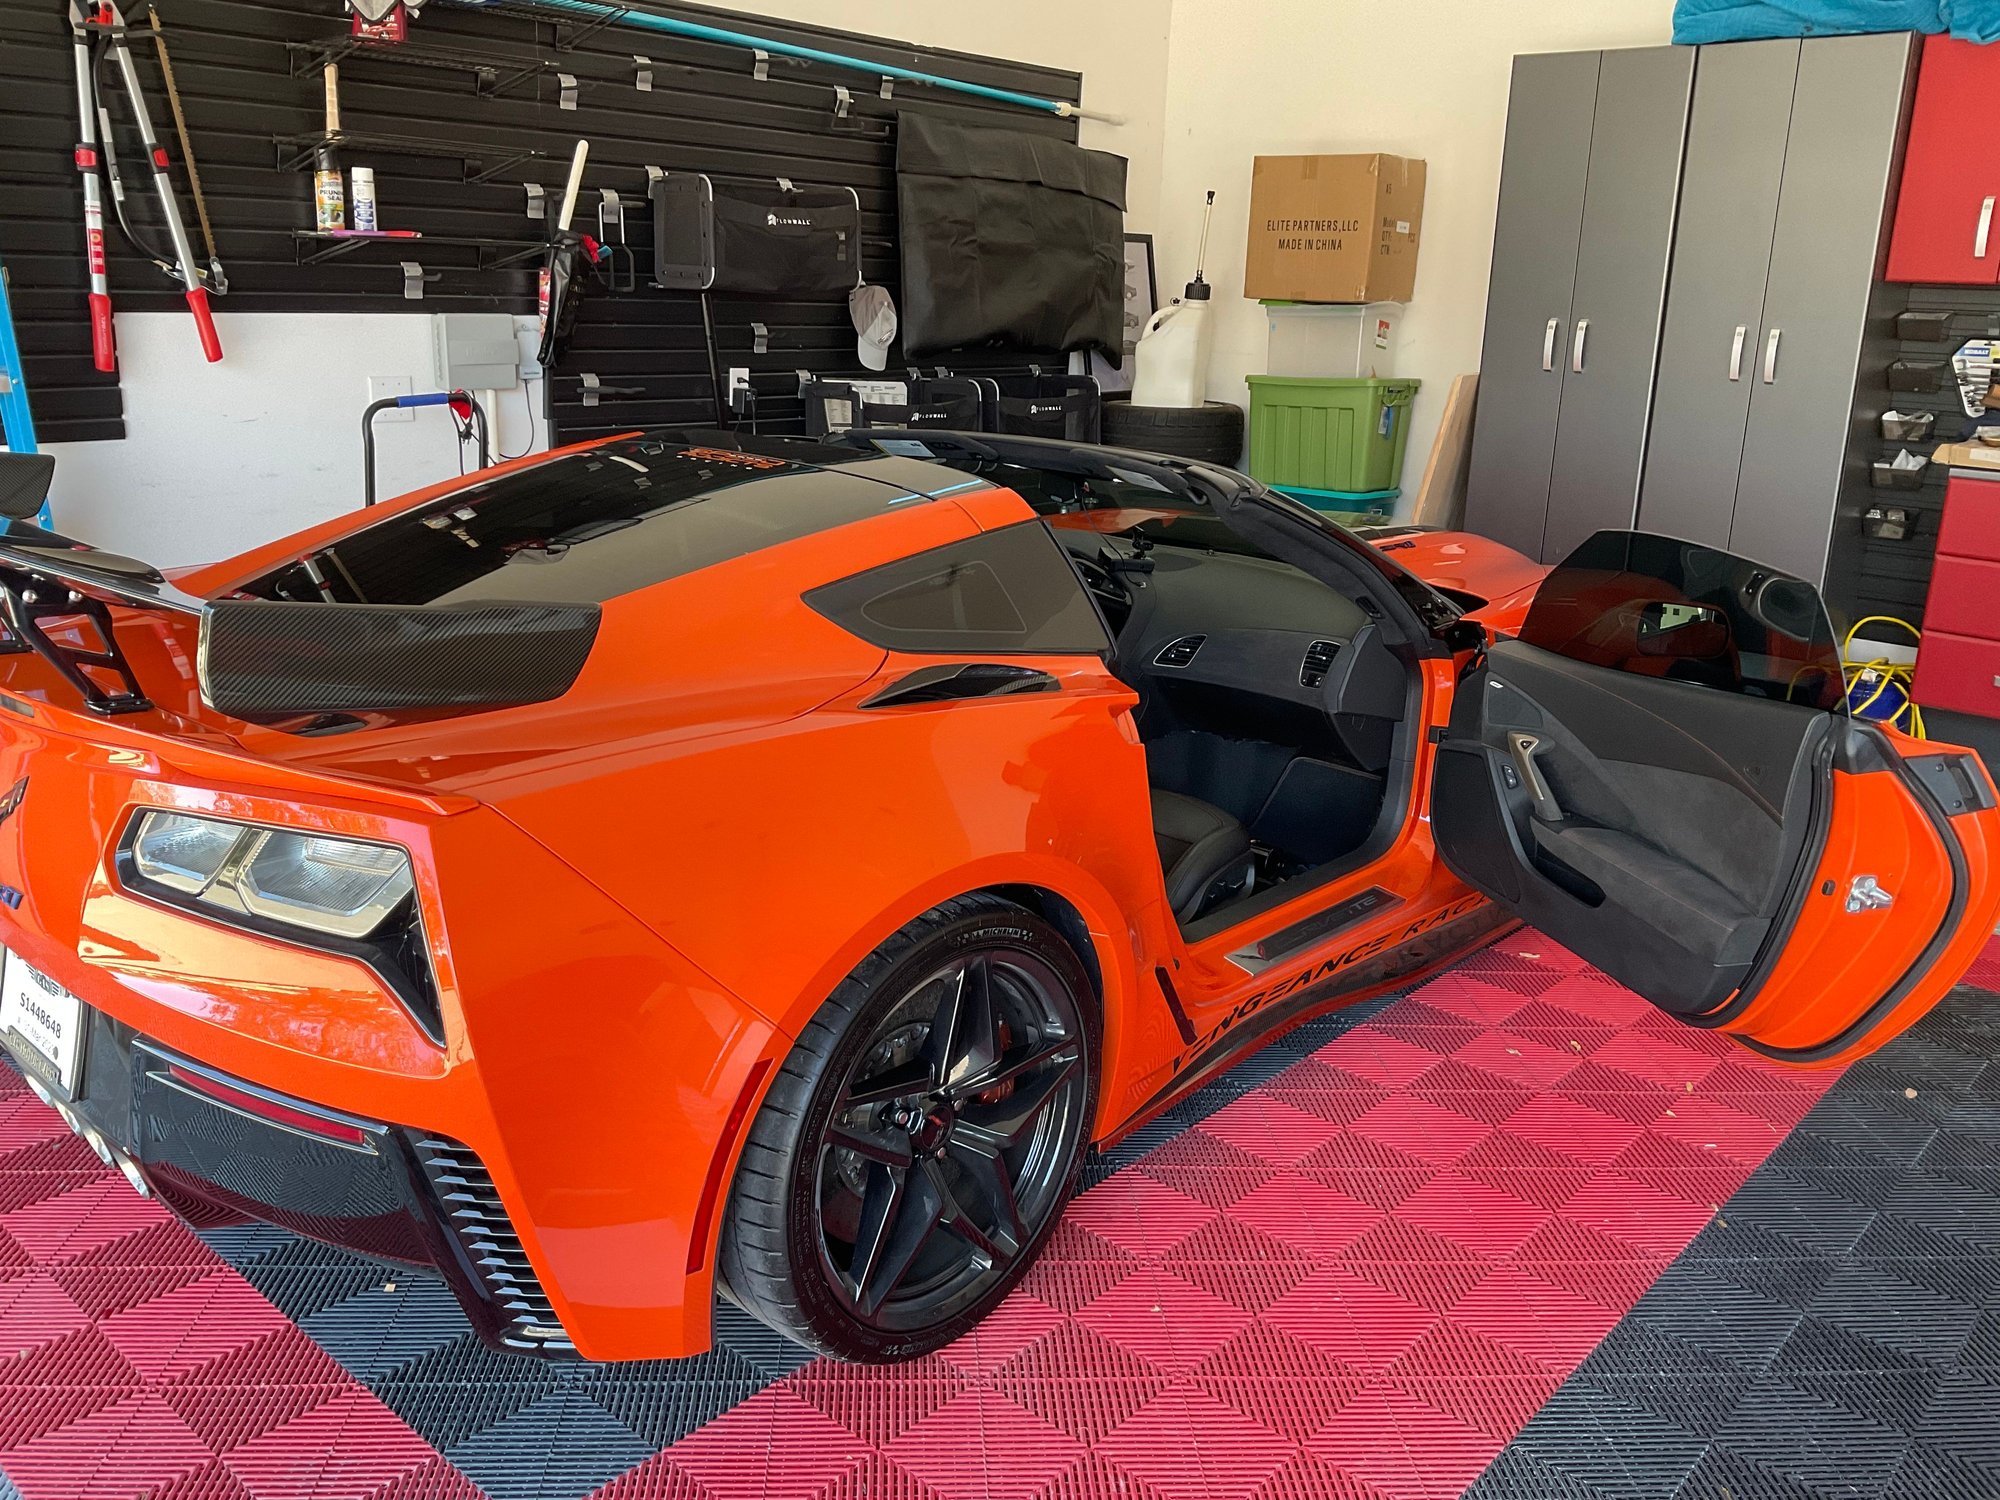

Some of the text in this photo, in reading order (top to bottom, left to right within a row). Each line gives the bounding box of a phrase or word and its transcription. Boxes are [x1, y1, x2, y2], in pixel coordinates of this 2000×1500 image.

[1266, 219, 1291, 232] ELITE
[1278, 238, 1343, 251] MADE IN CHINA
[982, 927, 1021, 938] MICHELIN
[1174, 933, 1392, 1074] VENGEANCE
[20, 992, 62, 1039] S1448648
